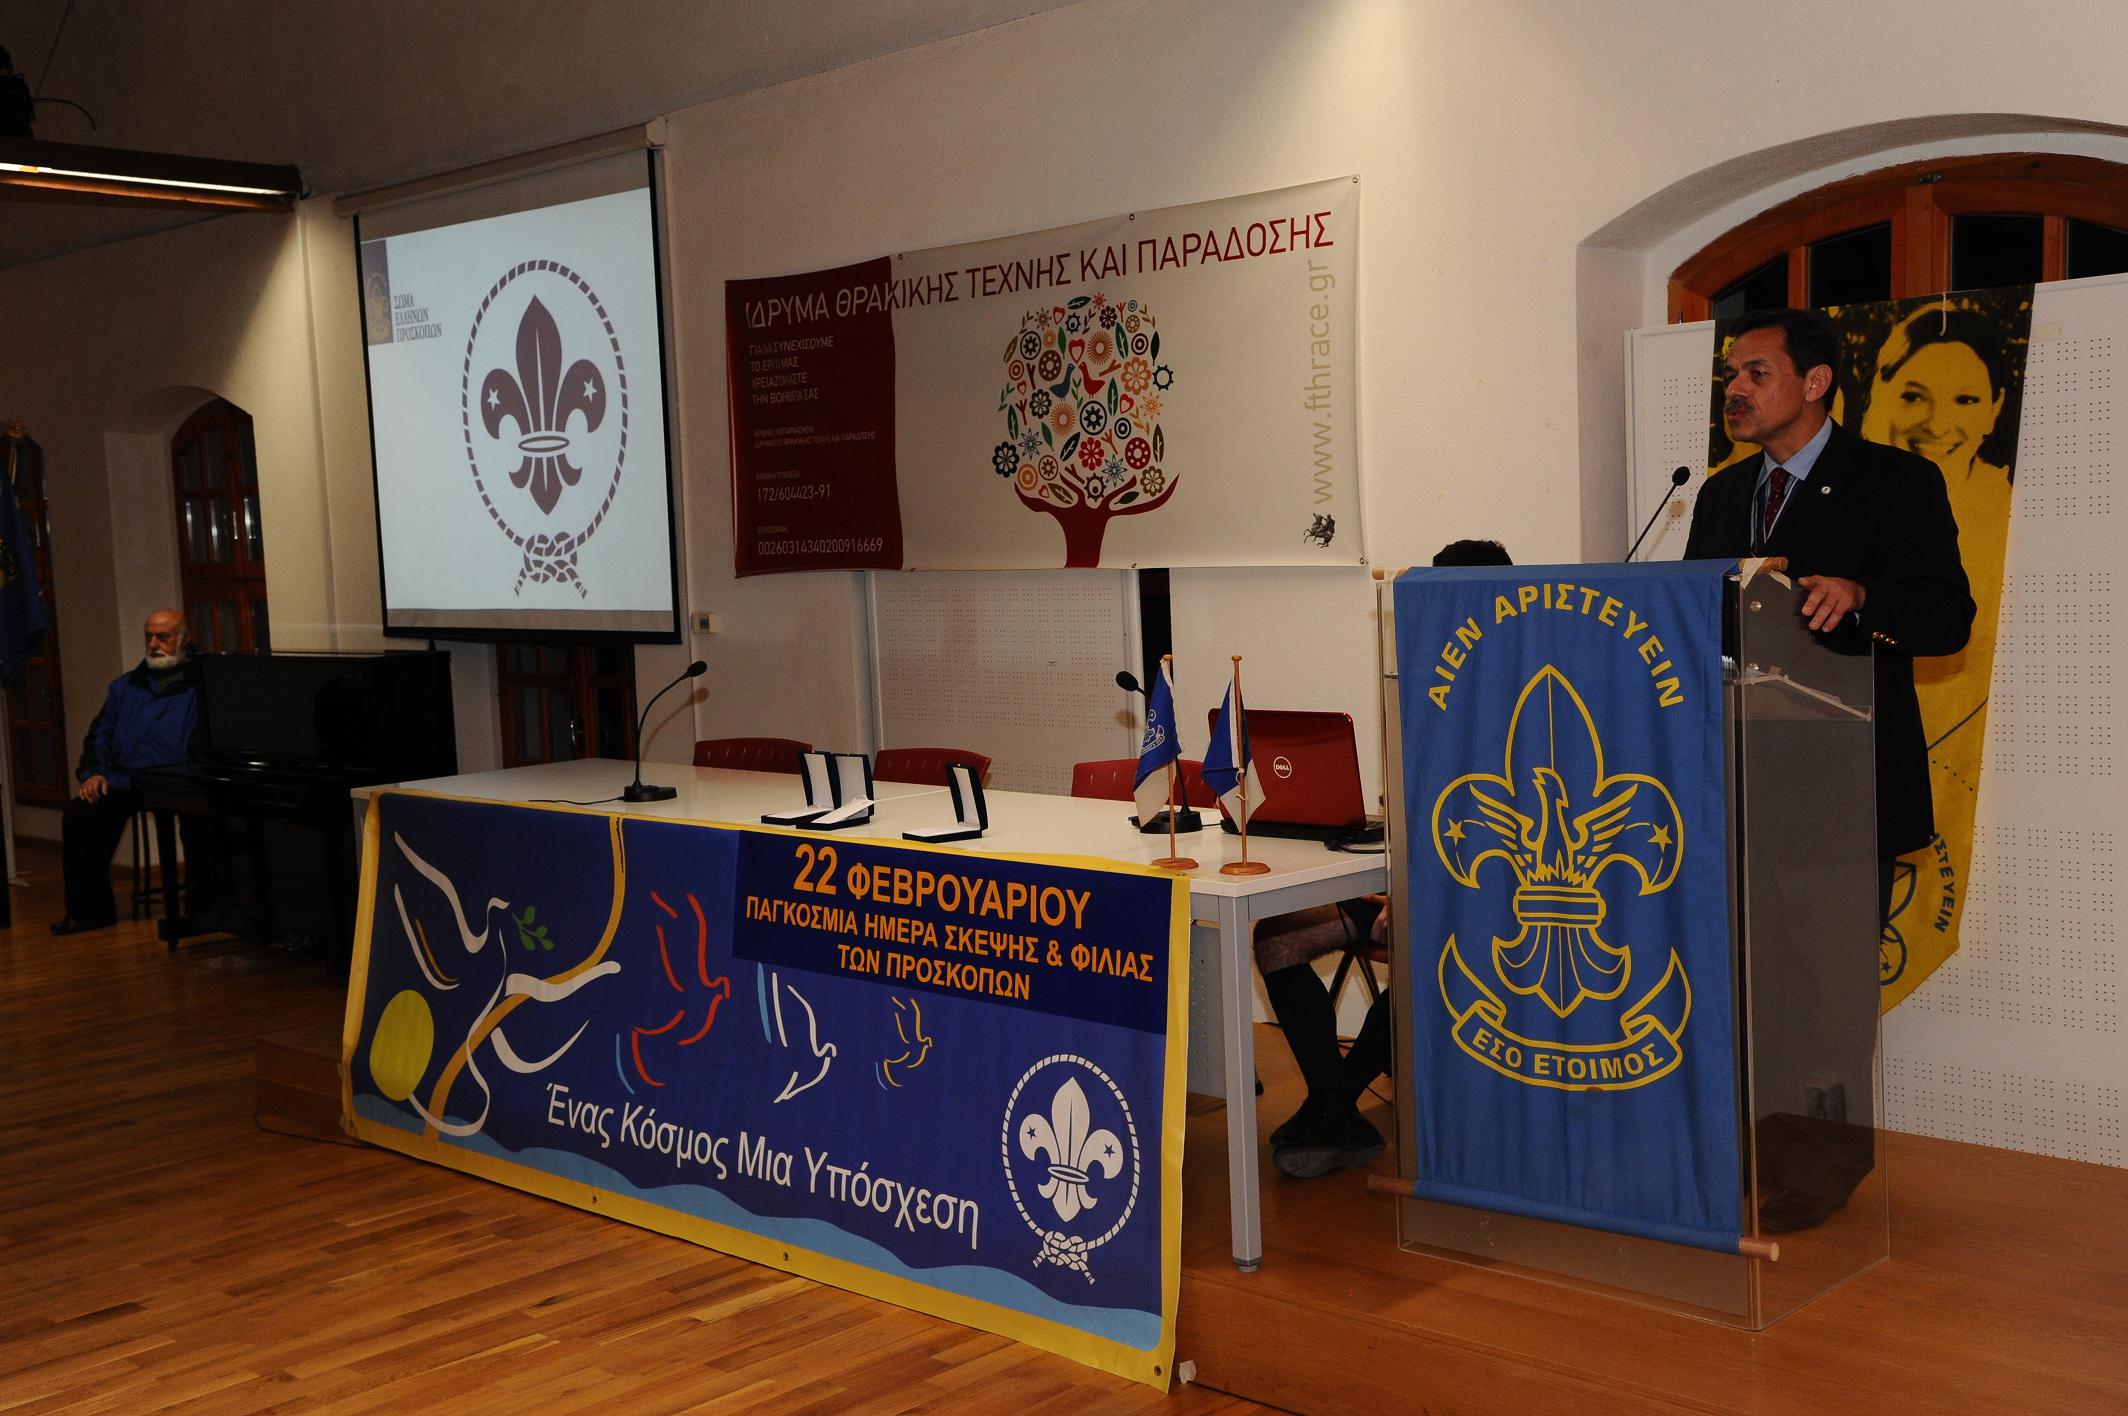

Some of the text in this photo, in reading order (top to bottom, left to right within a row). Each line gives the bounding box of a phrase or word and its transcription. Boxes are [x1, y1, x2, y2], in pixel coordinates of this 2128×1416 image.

[745, 211, 1334, 328] ΙΔΡΥΜΑ ΘΡΑΚΙΚΗΣ ΤΕΧΝΗΣ ΚΑΙ ΠΑΡΑΔΟΣΗΣ
[1304, 259, 1336, 505] www.fthrace.gr
[1428, 583, 1684, 711] ΑΙΕΝ ΑΡΙΣΤΕΥΕΙΝ
[793, 843, 1091, 929] 22 ΦΕΒΡΟΥΑΡΙΟΥ
[746, 896, 1154, 982] ΠΑΓΚΟΣΜΙΑ ΗΜΕΡΑ ΣΚΕΨΗΣ & ΦΙΛΙΑΣ
[837, 944, 1030, 1000] ΤΩΝ ΠΡΟΣΚΟΠΩΝ
[1472, 1027, 1664, 1079] ΕΣΟ ΕΤΟΙΜΟΣ
[546, 1083, 979, 1250] Ένας Κόσμος Μια Υπόσχεση
